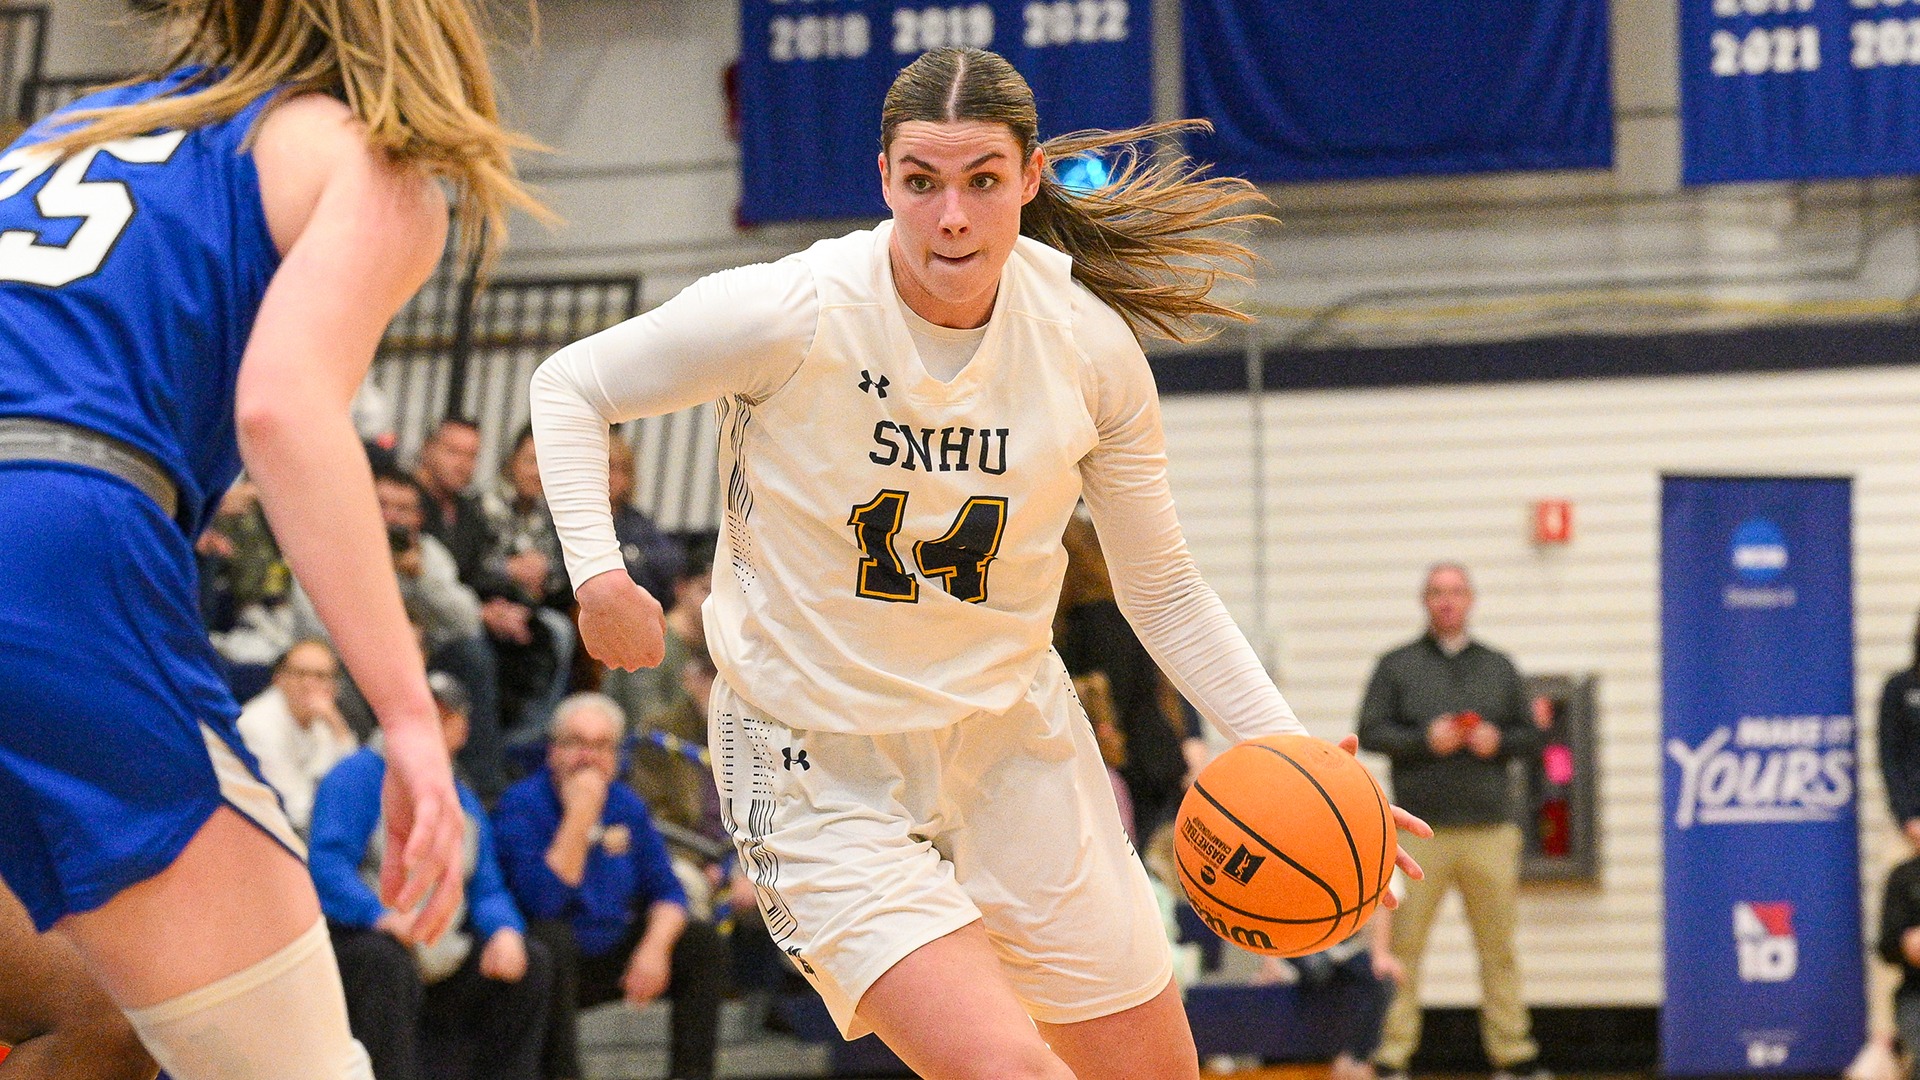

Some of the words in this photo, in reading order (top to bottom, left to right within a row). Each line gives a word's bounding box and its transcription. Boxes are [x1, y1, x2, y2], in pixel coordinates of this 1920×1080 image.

[1023, 1, 1128, 48] 2022
[1711, 25, 1821, 76] 2021
[869, 420, 1009, 475] SNHU
[847, 488, 1009, 604] 14
[1183, 816, 1227, 865] BASKETBALL
